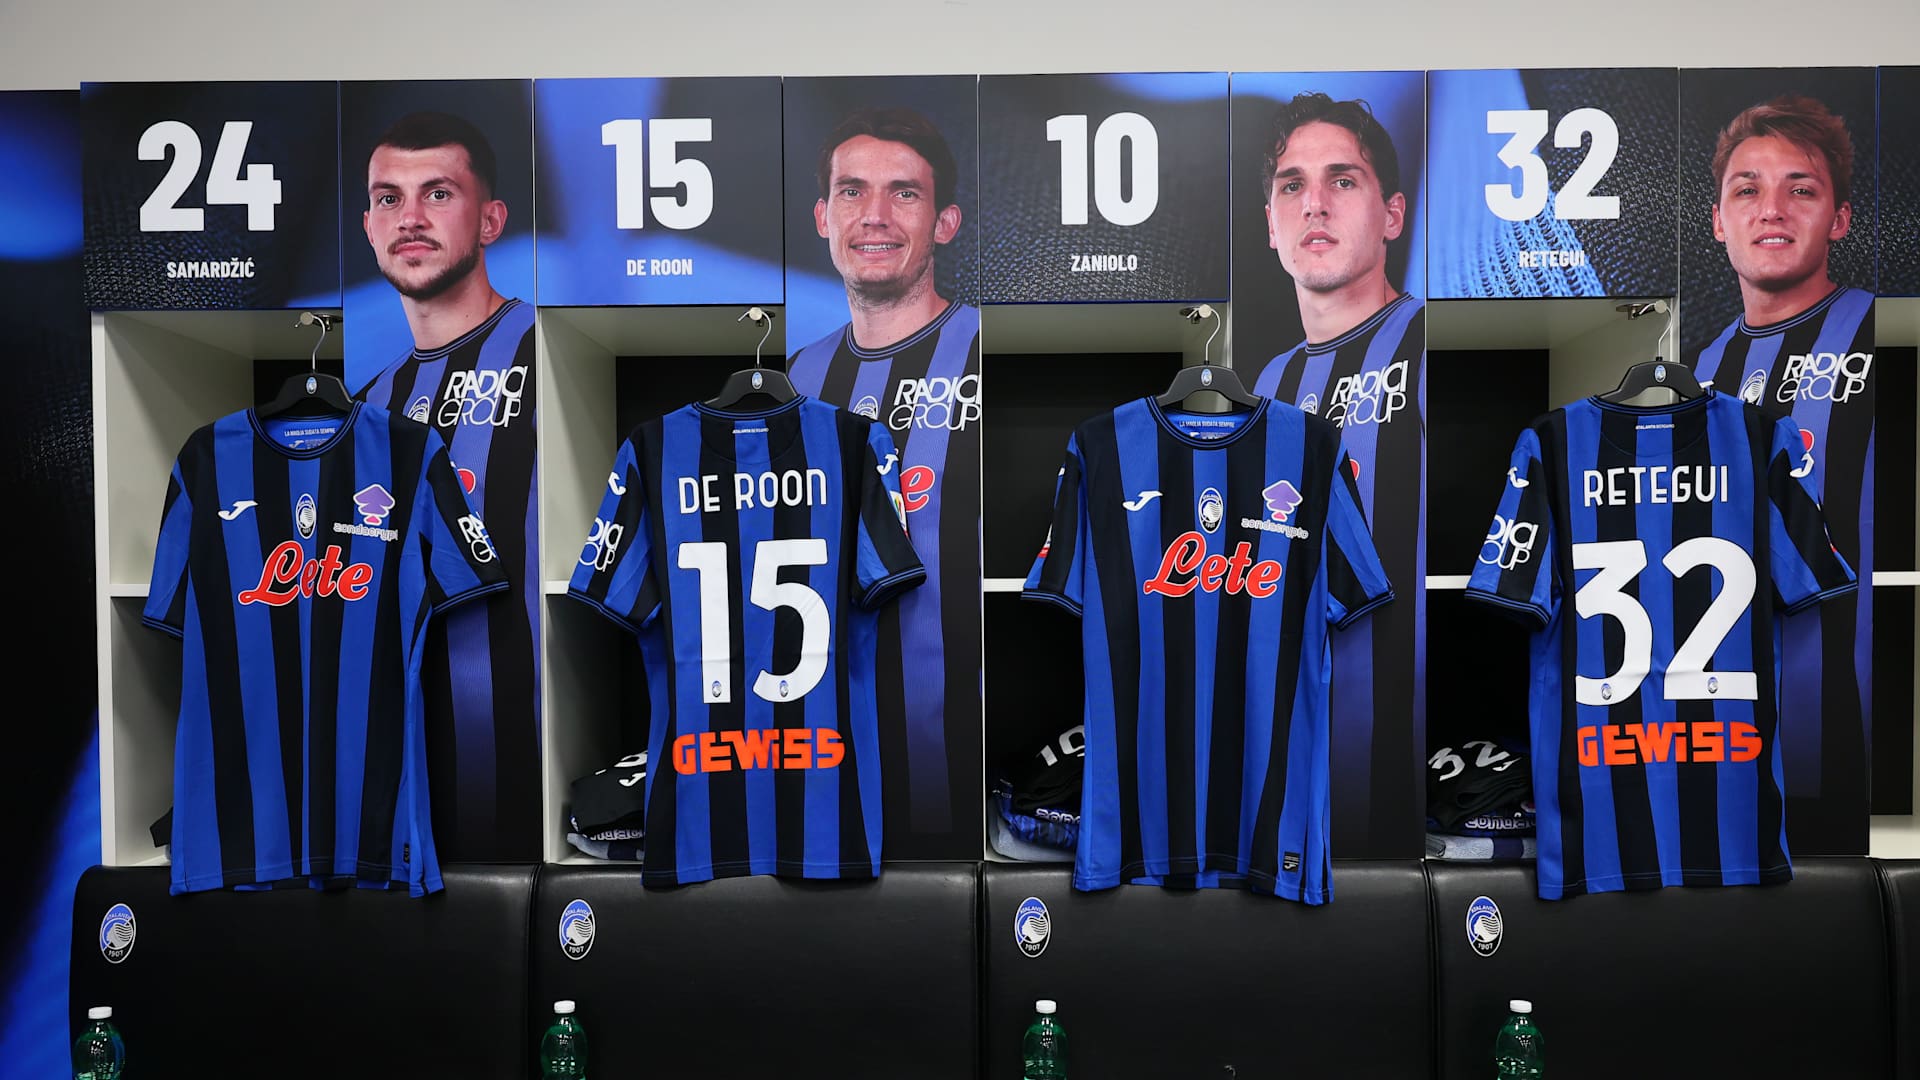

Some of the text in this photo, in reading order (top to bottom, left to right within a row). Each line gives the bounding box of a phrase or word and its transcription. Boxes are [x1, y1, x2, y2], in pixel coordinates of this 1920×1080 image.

[138, 120, 282, 232] 24
[601, 118, 714, 230] 15
[1046, 112, 1159, 226] 10
[1485, 107, 1621, 222] 32
[166, 257, 256, 279] SAMARDŽIĆ
[626, 258, 693, 276] DE ROON
[1071, 254, 1138, 272] ZANIOLO
[1519, 250, 1585, 268] RETEGUI
[443, 365, 528, 400] RADICI
[1330, 360, 1409, 405] RADICI
[1782, 352, 1874, 381] RADICI
[1776, 375, 1865, 404] GROUP
[437, 397, 521, 428] GROUP
[888, 403, 981, 431] GROUP
[678, 468, 827, 514] DE ROON
[1583, 465, 1728, 507] RETEGUI
[1241, 518, 1309, 539] zondacrypto
[238, 540, 374, 606] Lete
[579, 541, 615, 572] OUP
[1143, 531, 1283, 598] Lete
[1478, 540, 1530, 571] OUP
[678, 538, 831, 704] 15
[1572, 537, 1758, 706] 32
